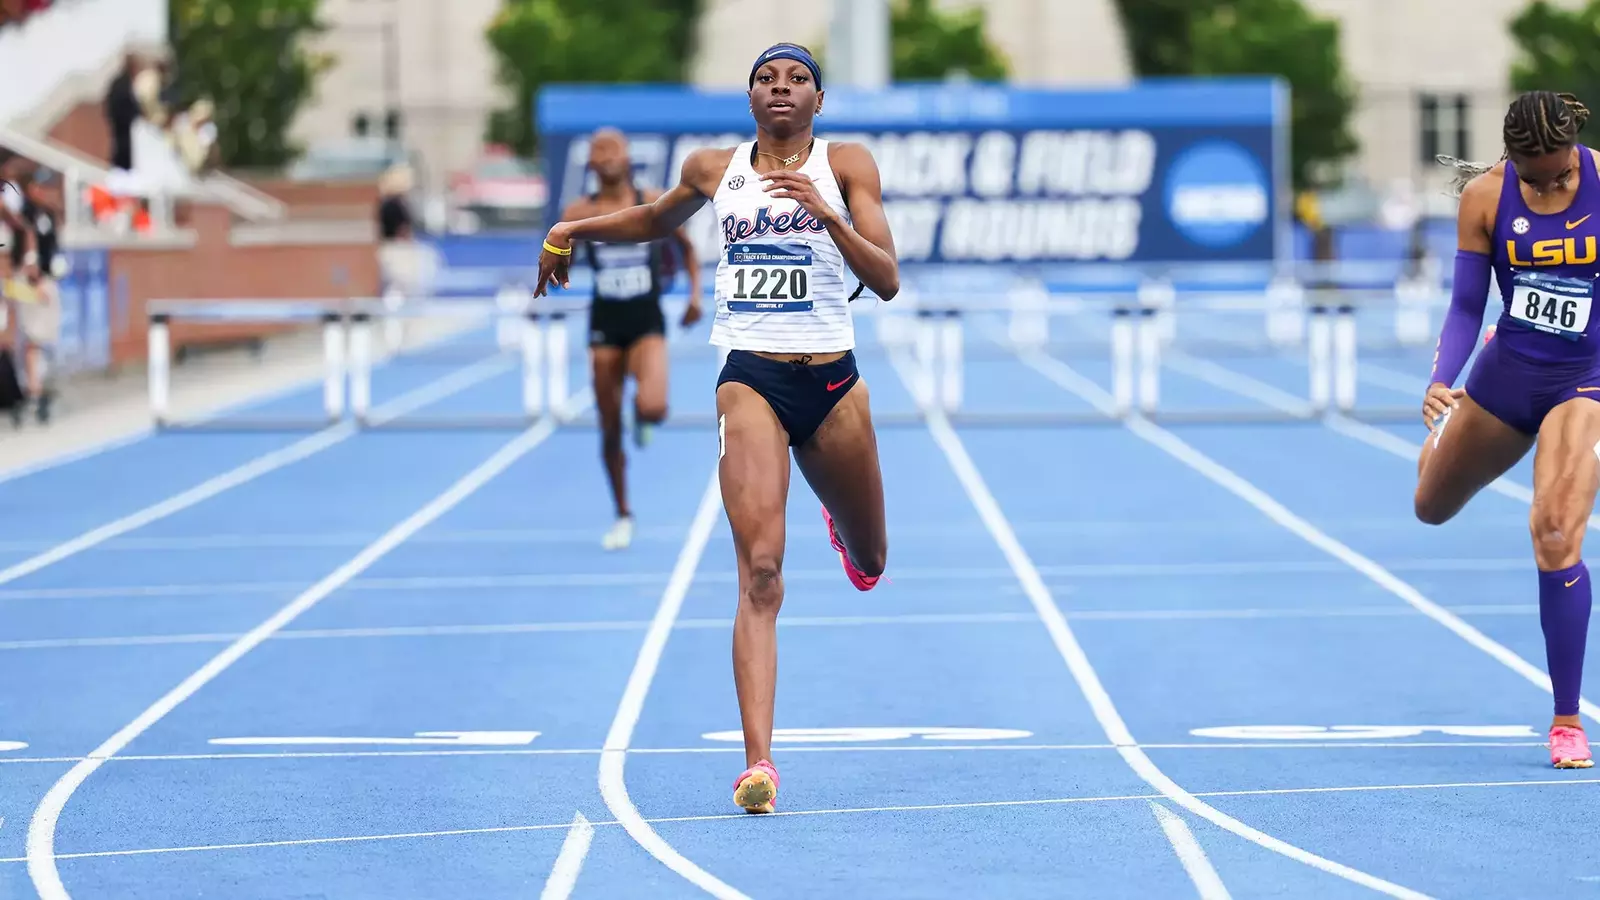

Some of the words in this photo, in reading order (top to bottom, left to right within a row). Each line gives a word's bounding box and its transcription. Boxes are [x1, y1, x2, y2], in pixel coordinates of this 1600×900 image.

[722, 205, 828, 244] Rebels
[1506, 235, 1597, 267] LSU
[733, 268, 807, 300] 1220
[1525, 291, 1578, 328] 846
